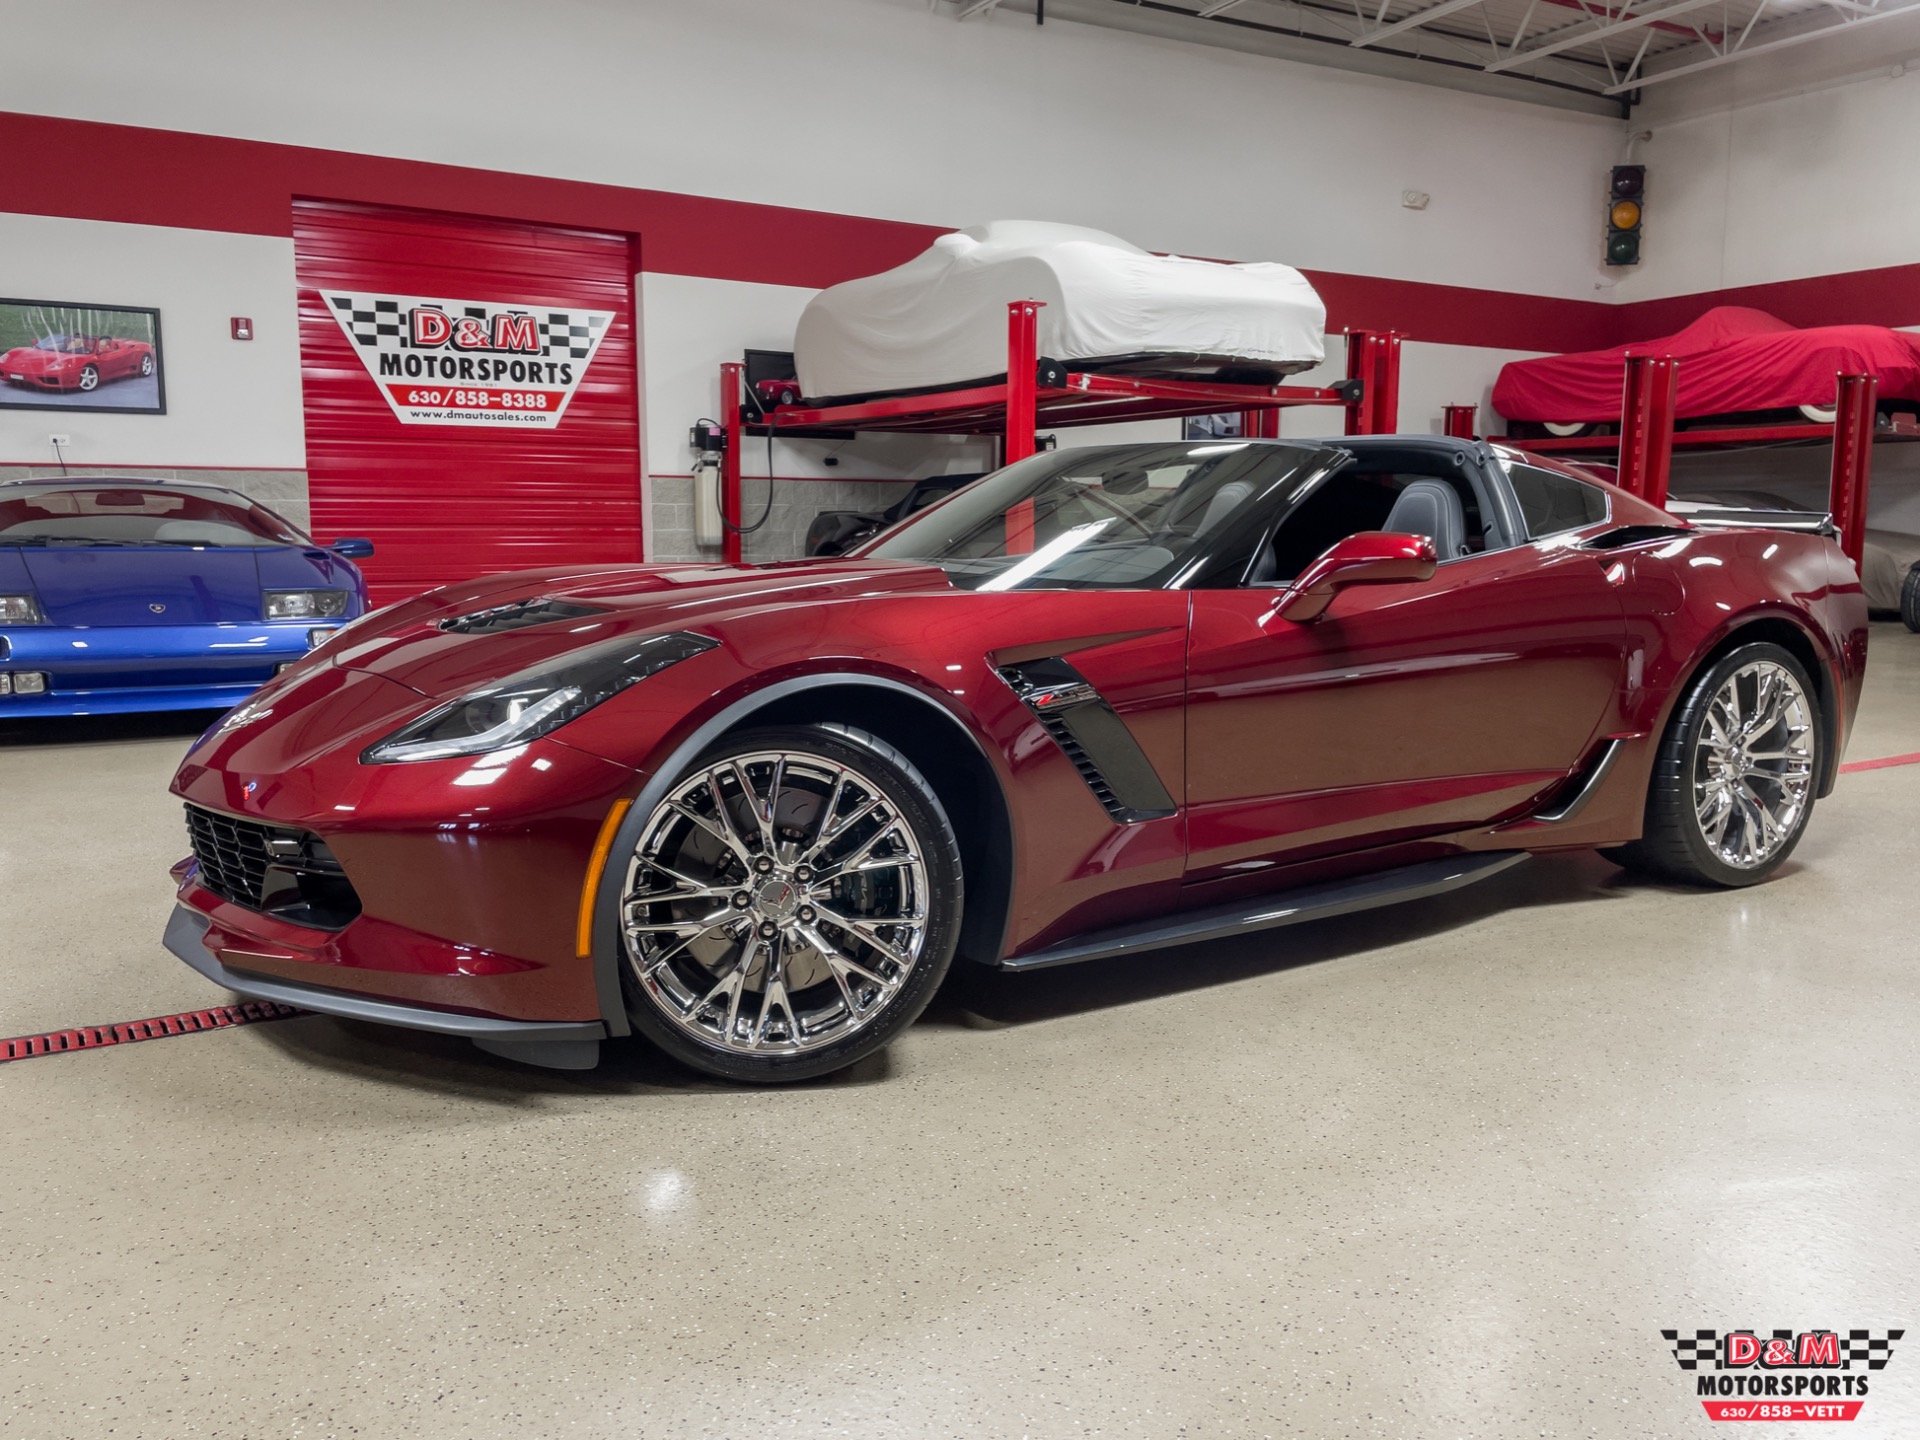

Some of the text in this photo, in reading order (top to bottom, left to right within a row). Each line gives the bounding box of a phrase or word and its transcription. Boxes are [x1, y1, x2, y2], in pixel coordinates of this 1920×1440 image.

[409, 307, 541, 355] D&M
[379, 352, 573, 385] MOTORSPORTS
[408, 389, 547, 409] 630/858-8388
[410, 410, 547, 423] www.dmautosales.com
